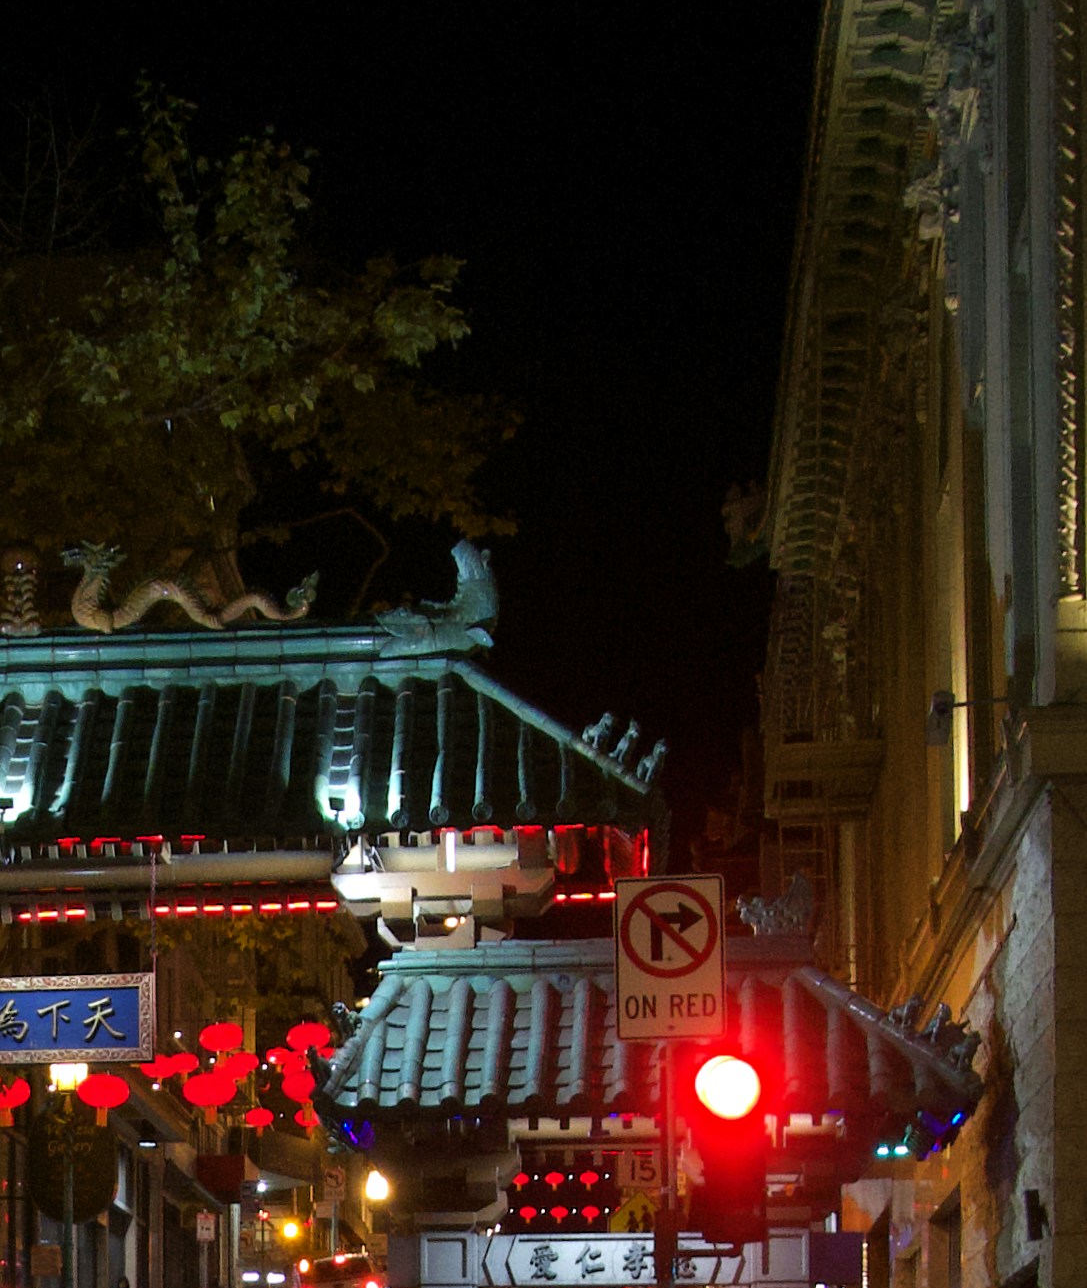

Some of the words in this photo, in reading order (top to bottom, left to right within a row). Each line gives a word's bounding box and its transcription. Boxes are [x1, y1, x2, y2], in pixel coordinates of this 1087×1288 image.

[625, 994, 657, 1020] ON
[670, 993, 717, 1018] RED
[630, 1159, 656, 1182] 15
